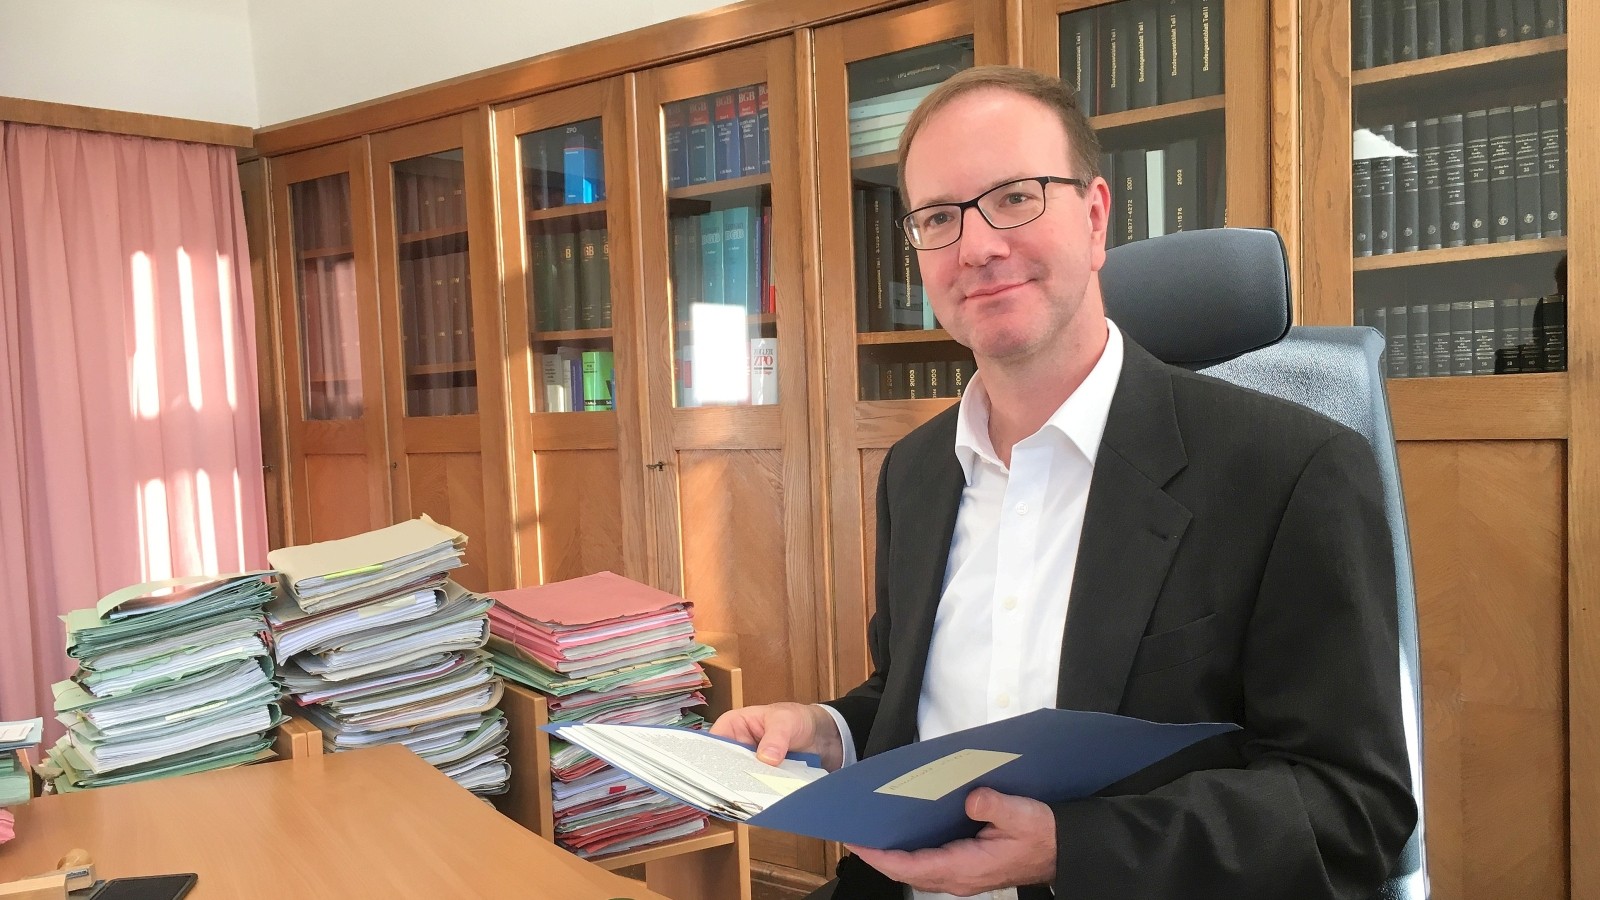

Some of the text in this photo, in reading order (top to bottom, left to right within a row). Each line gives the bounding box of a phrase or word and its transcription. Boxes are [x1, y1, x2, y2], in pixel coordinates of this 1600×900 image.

[715, 96, 732, 108] BGB
[738, 90, 756, 103] BGB
[725, 229, 745, 240] BGB
[754, 356, 774, 366] ZPO
